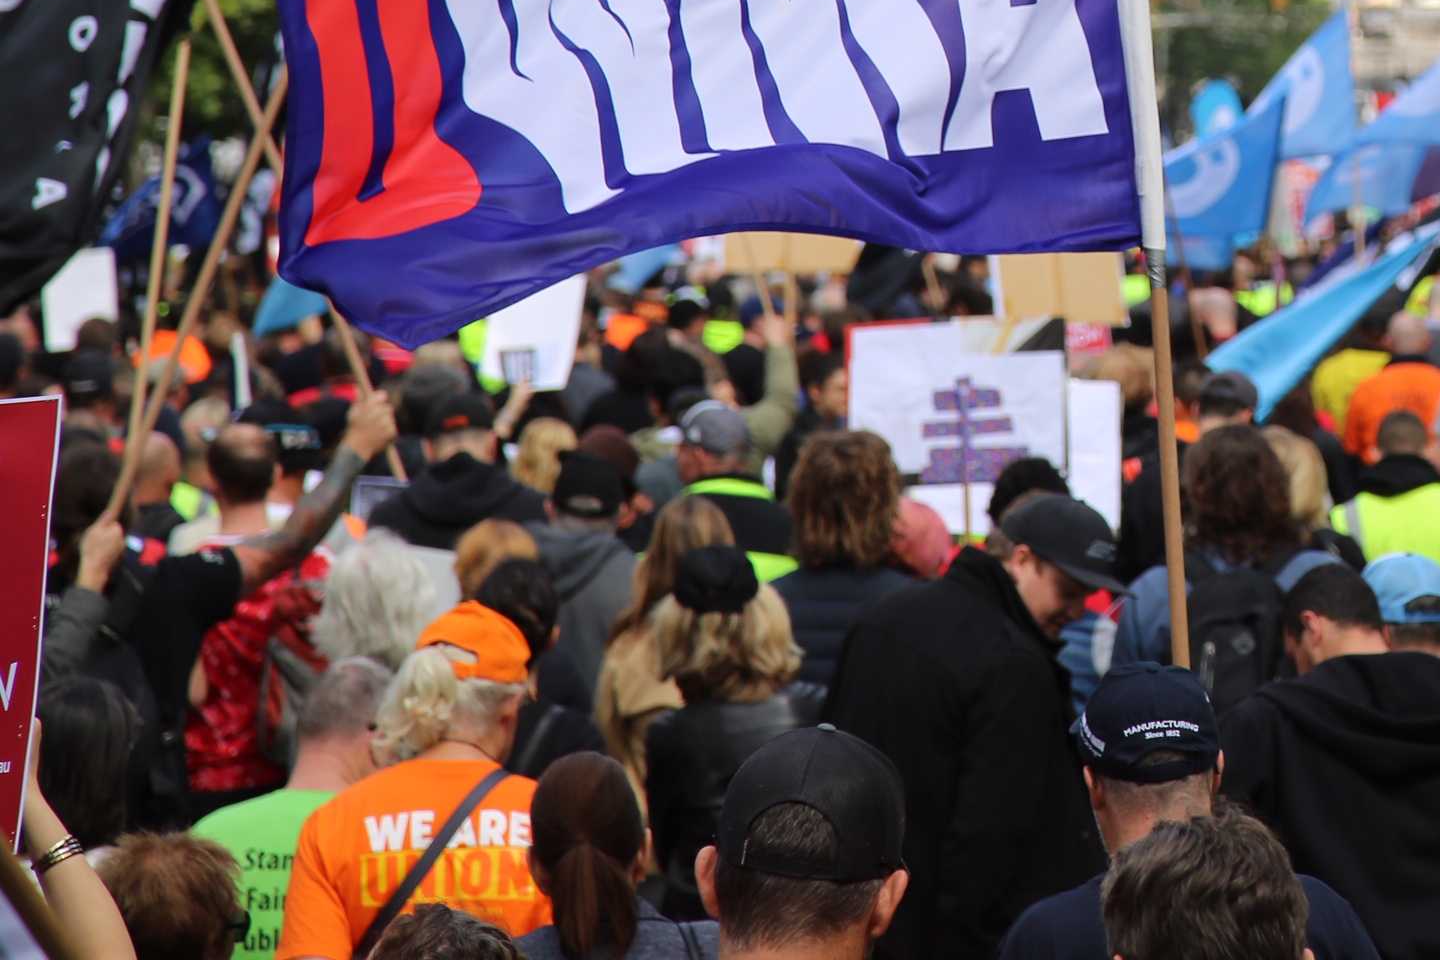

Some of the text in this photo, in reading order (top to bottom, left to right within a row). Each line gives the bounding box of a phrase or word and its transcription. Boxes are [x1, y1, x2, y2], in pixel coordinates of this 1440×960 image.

[1124, 720, 1200, 737] MANUFACTURING
[364, 809, 533, 853] WE ARE
[244, 847, 294, 871] Stan
[244, 928, 280, 952] ubl
